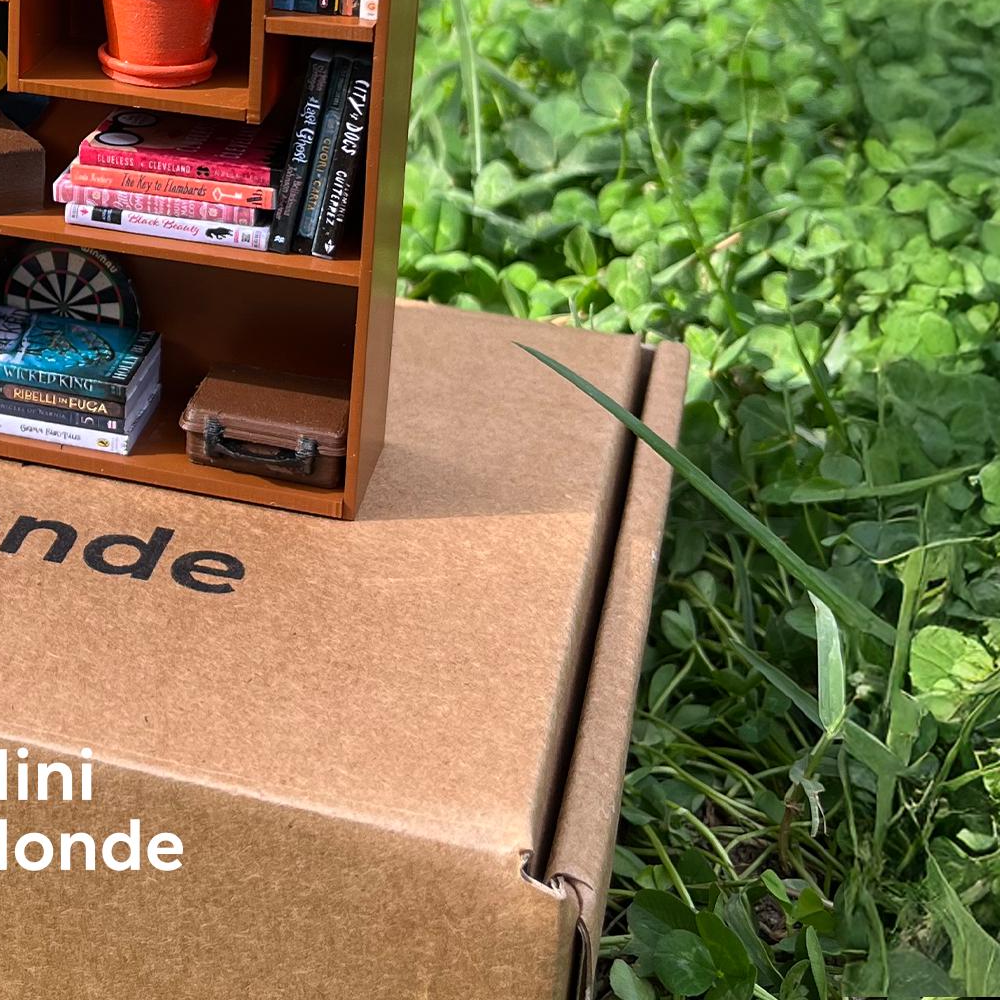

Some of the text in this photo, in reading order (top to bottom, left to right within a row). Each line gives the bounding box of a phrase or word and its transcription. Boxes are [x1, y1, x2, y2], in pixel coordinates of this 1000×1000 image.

[344, 77, 370, 116] CITY
[290, 101, 320, 166] Last Ghost
[339, 121, 363, 157] DOGS
[97, 154, 191, 174] CLUELESS CLEVELAND
[306, 136, 331, 212] CUORI CARTA
[121, 173, 207, 197] The Key to Flambards
[127, 214, 160, 227] Black
[162, 218, 201, 236] Beauty
[3, 365, 92, 392] WICKED KING
[111, 355, 138, 381] HOLLY
[13, 388, 56, 405] RIBELLI
[69, 398, 108, 414] FUGA
[39, 410, 66, 418] NARNIA
